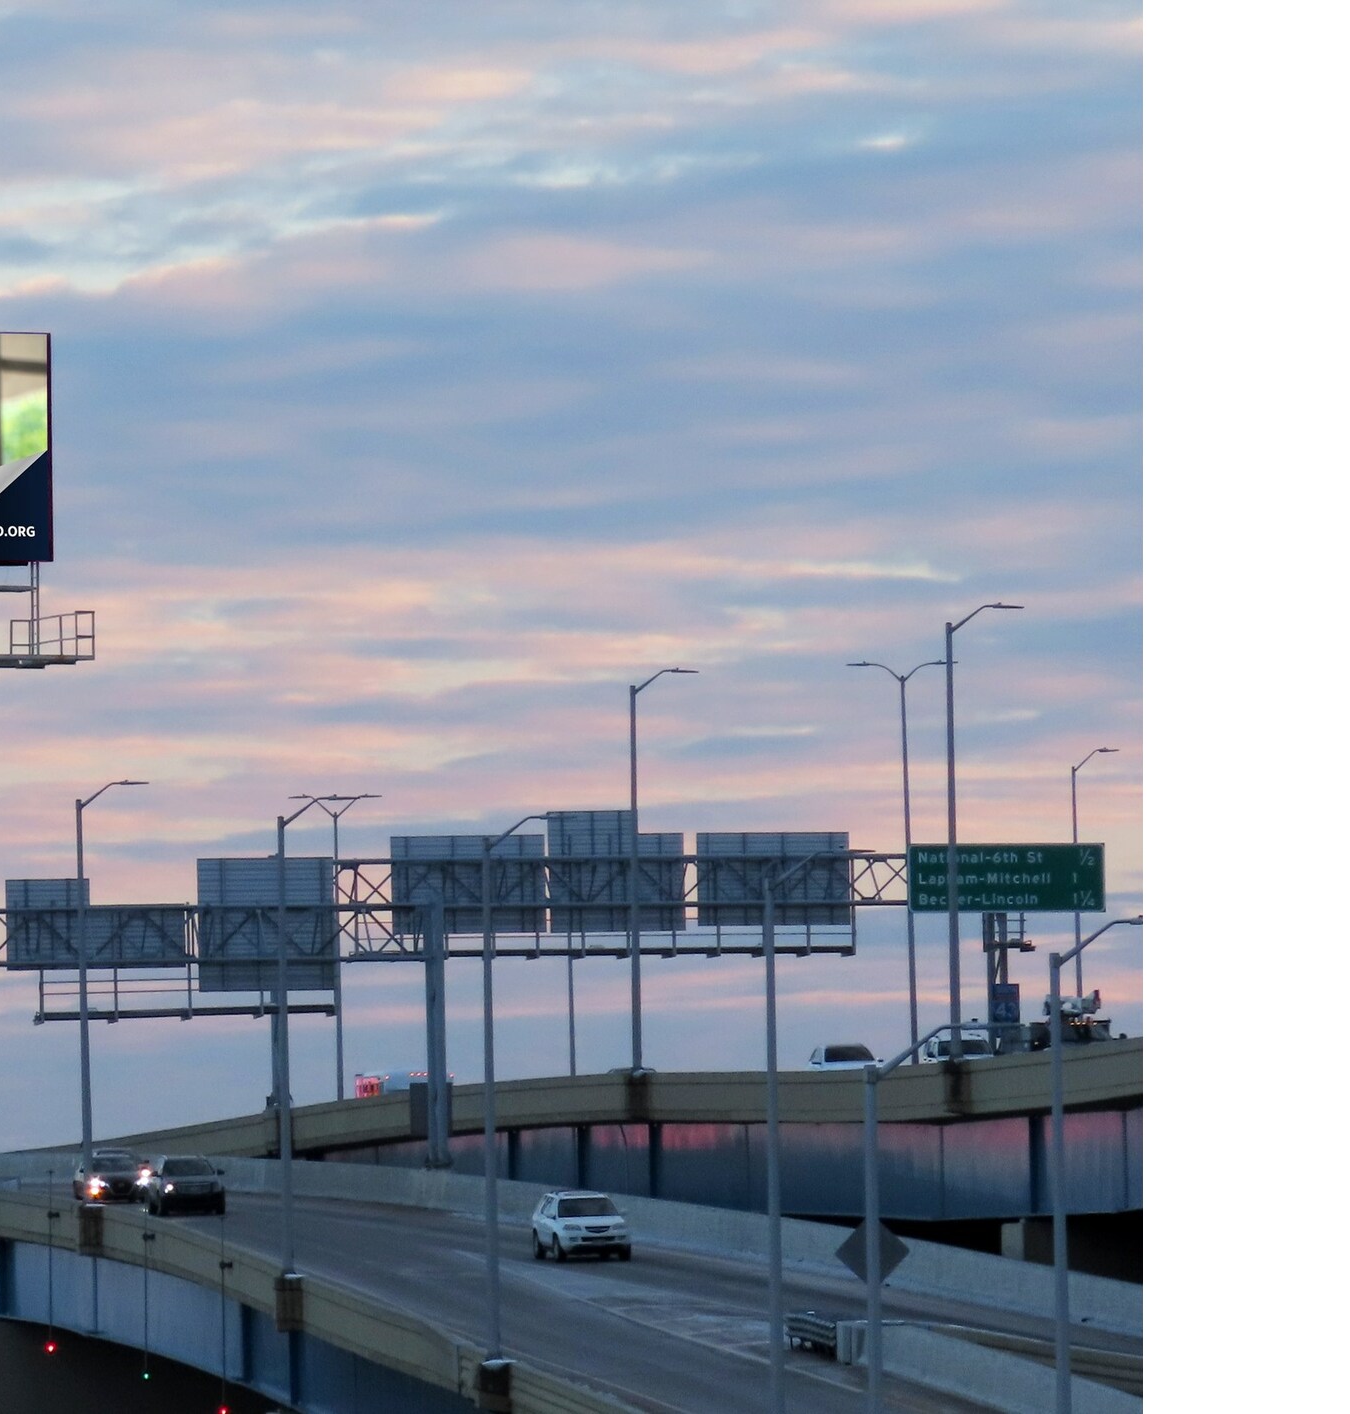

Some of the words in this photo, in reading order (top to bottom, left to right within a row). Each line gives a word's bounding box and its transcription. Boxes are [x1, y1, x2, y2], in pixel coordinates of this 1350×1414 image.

[1027, 852, 1043, 864] St
[918, 872, 1051, 886] Lapam-Mitchell
[1072, 872, 1078, 884] 1
[919, 894, 1039, 906] Becer-Lincoln
